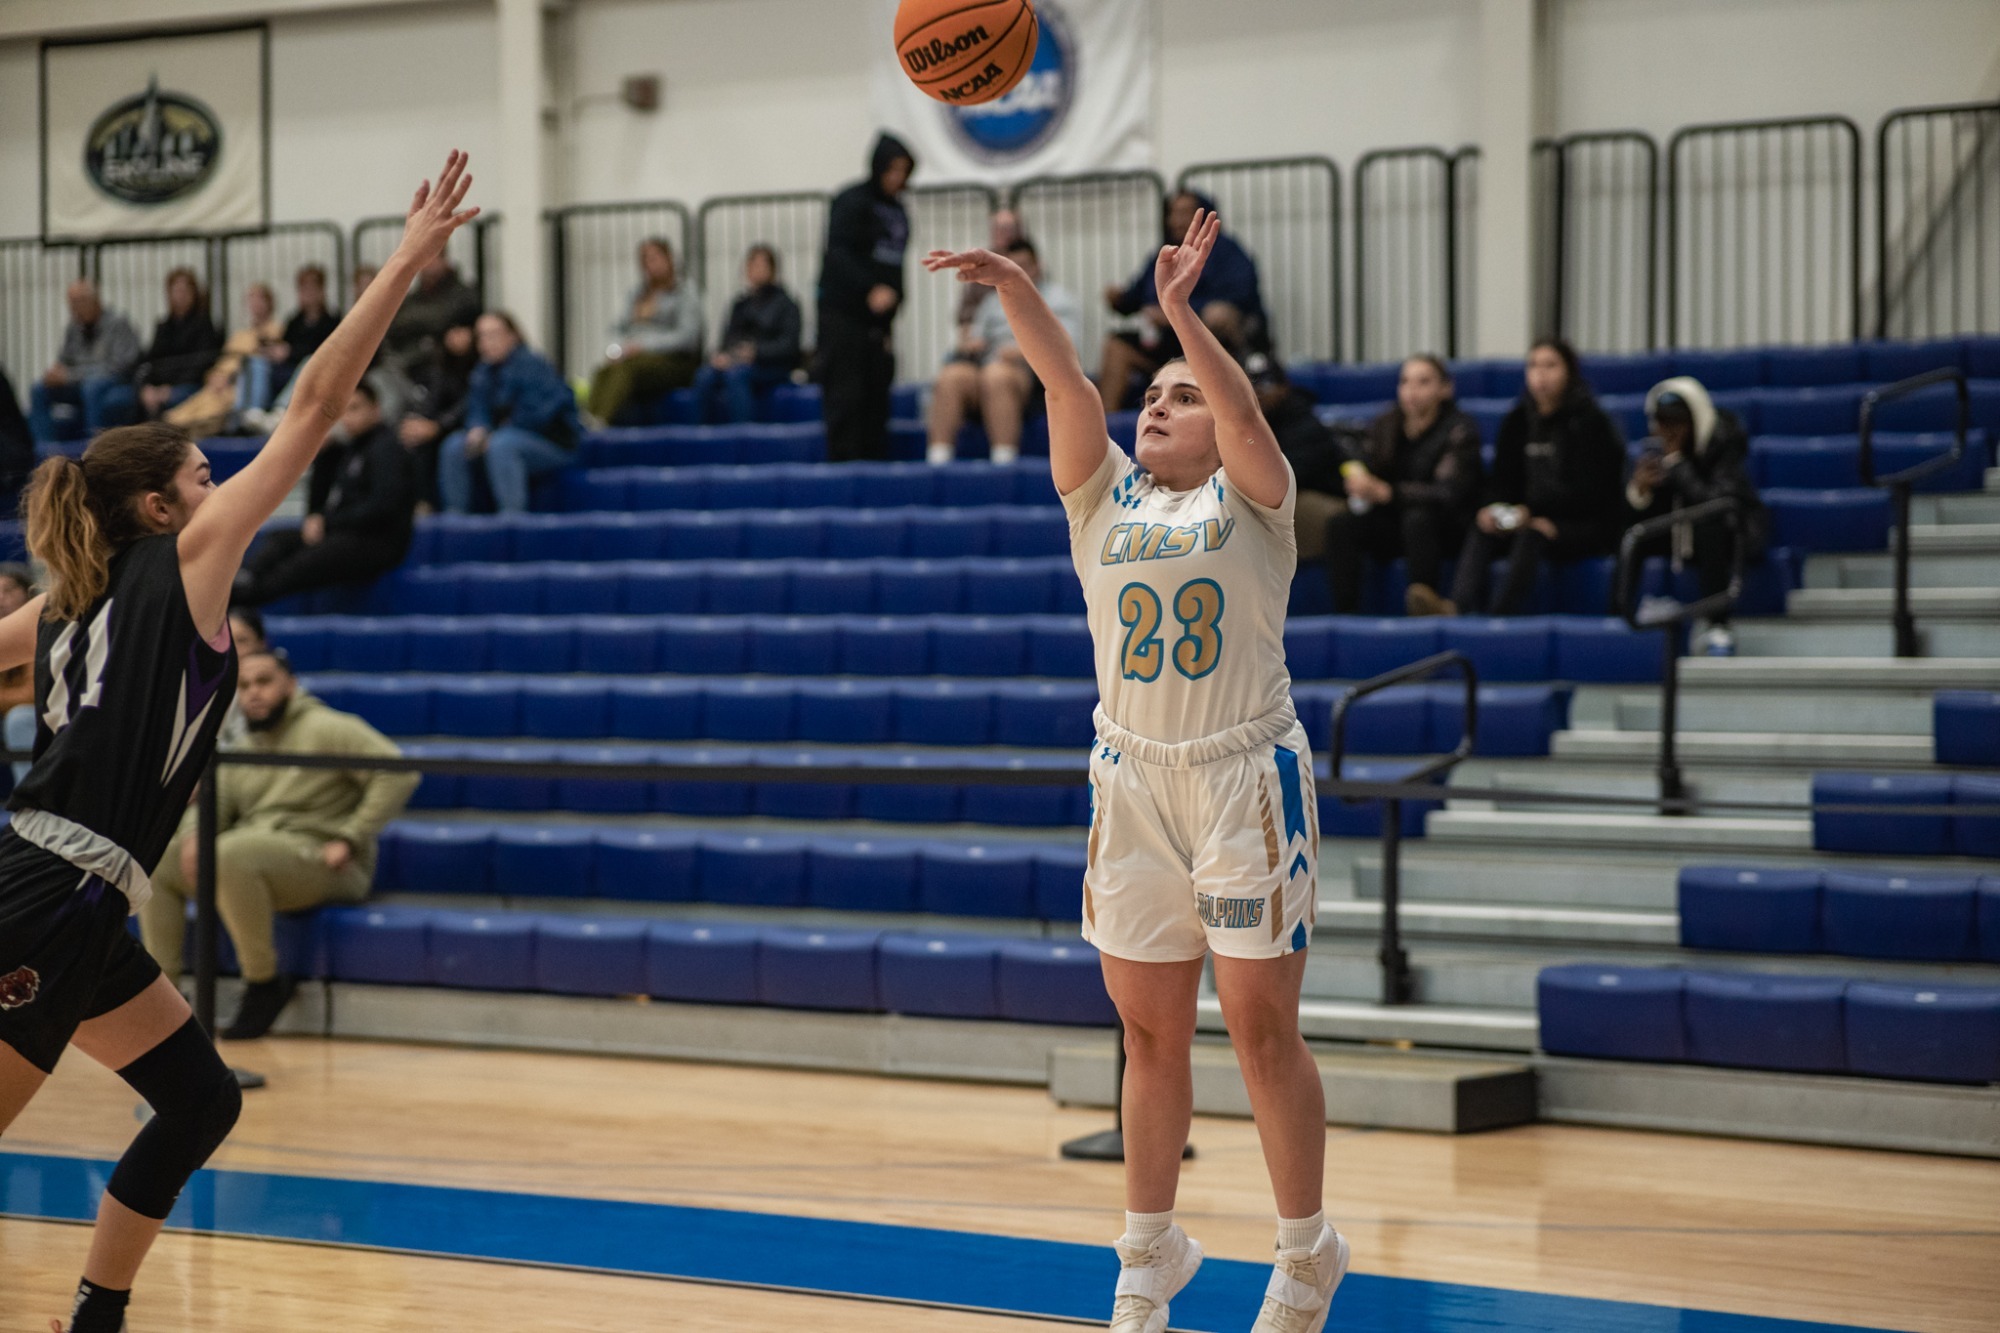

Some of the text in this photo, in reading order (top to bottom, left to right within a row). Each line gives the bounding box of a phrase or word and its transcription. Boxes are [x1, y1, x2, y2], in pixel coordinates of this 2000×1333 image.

[904, 26, 989, 74] Wilson
[939, 62, 1003, 100] NCAA
[1101, 518, 1235, 565] CMSV
[1118, 577, 1225, 683] 23
[42, 597, 114, 734] 11
